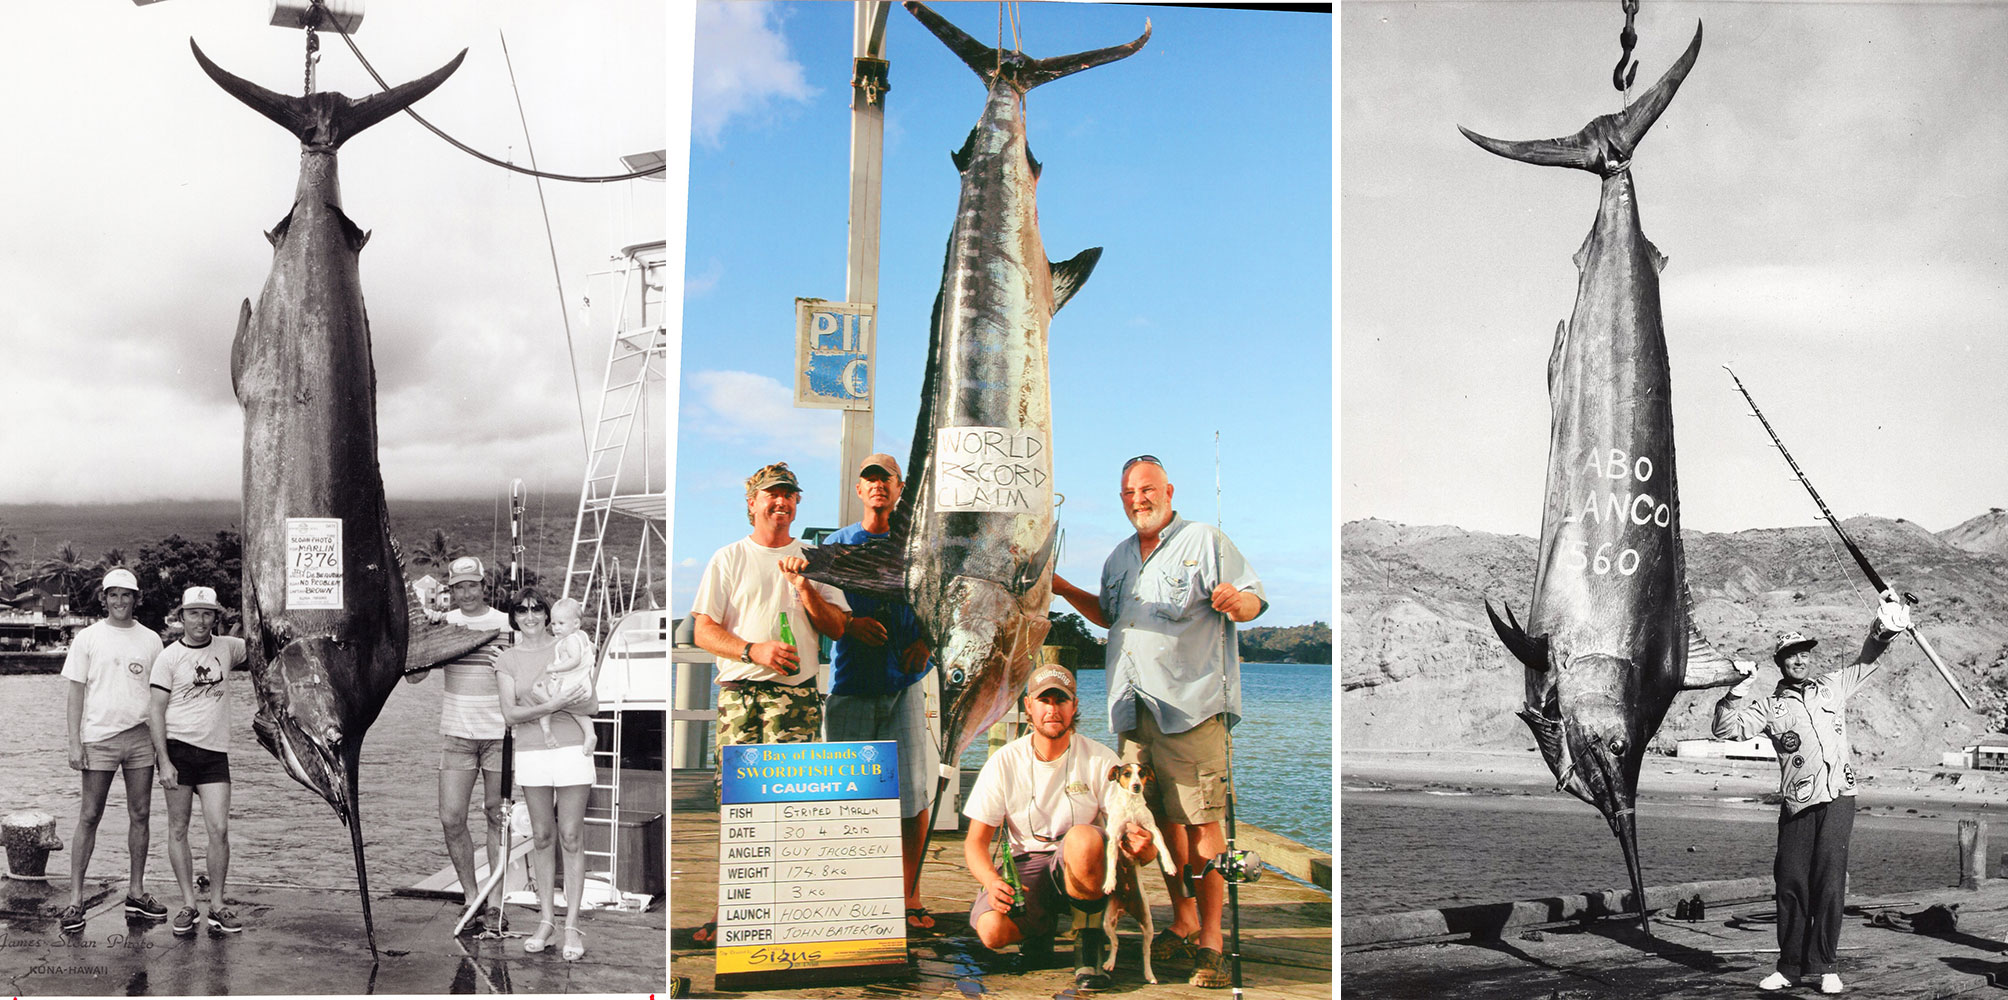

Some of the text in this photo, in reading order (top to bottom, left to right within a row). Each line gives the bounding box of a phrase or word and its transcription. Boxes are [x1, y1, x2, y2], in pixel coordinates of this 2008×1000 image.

[942, 431, 1042, 458] WORLD
[942, 462, 1047, 488] RECORD
[937, 487, 1029, 508] CLAIM
[298, 544, 335, 552] MARLIN
[296, 552, 338, 567] 1376
[763, 749, 857, 764] Bay of Islands
[737, 763, 882, 779] SWORDFISH CLUB
[762, 782, 858, 794] I CAUGHT A
[729, 808, 753, 818] FISH
[729, 825, 870, 839] DATE 30 4 2010
[728, 845, 889, 859] ANGLER GUY JACOBSEN
[727, 866, 769, 879] WEIGHT
[727, 888, 751, 900] LINE
[792, 886, 802, 898] 3
[726, 908, 771, 920] LAUNCH
[849, 903, 892, 917] BULL
[726, 928, 772, 942] SKIPPER
[783, 926, 824, 940] JOHN
[748, 948, 822, 970] Signs
